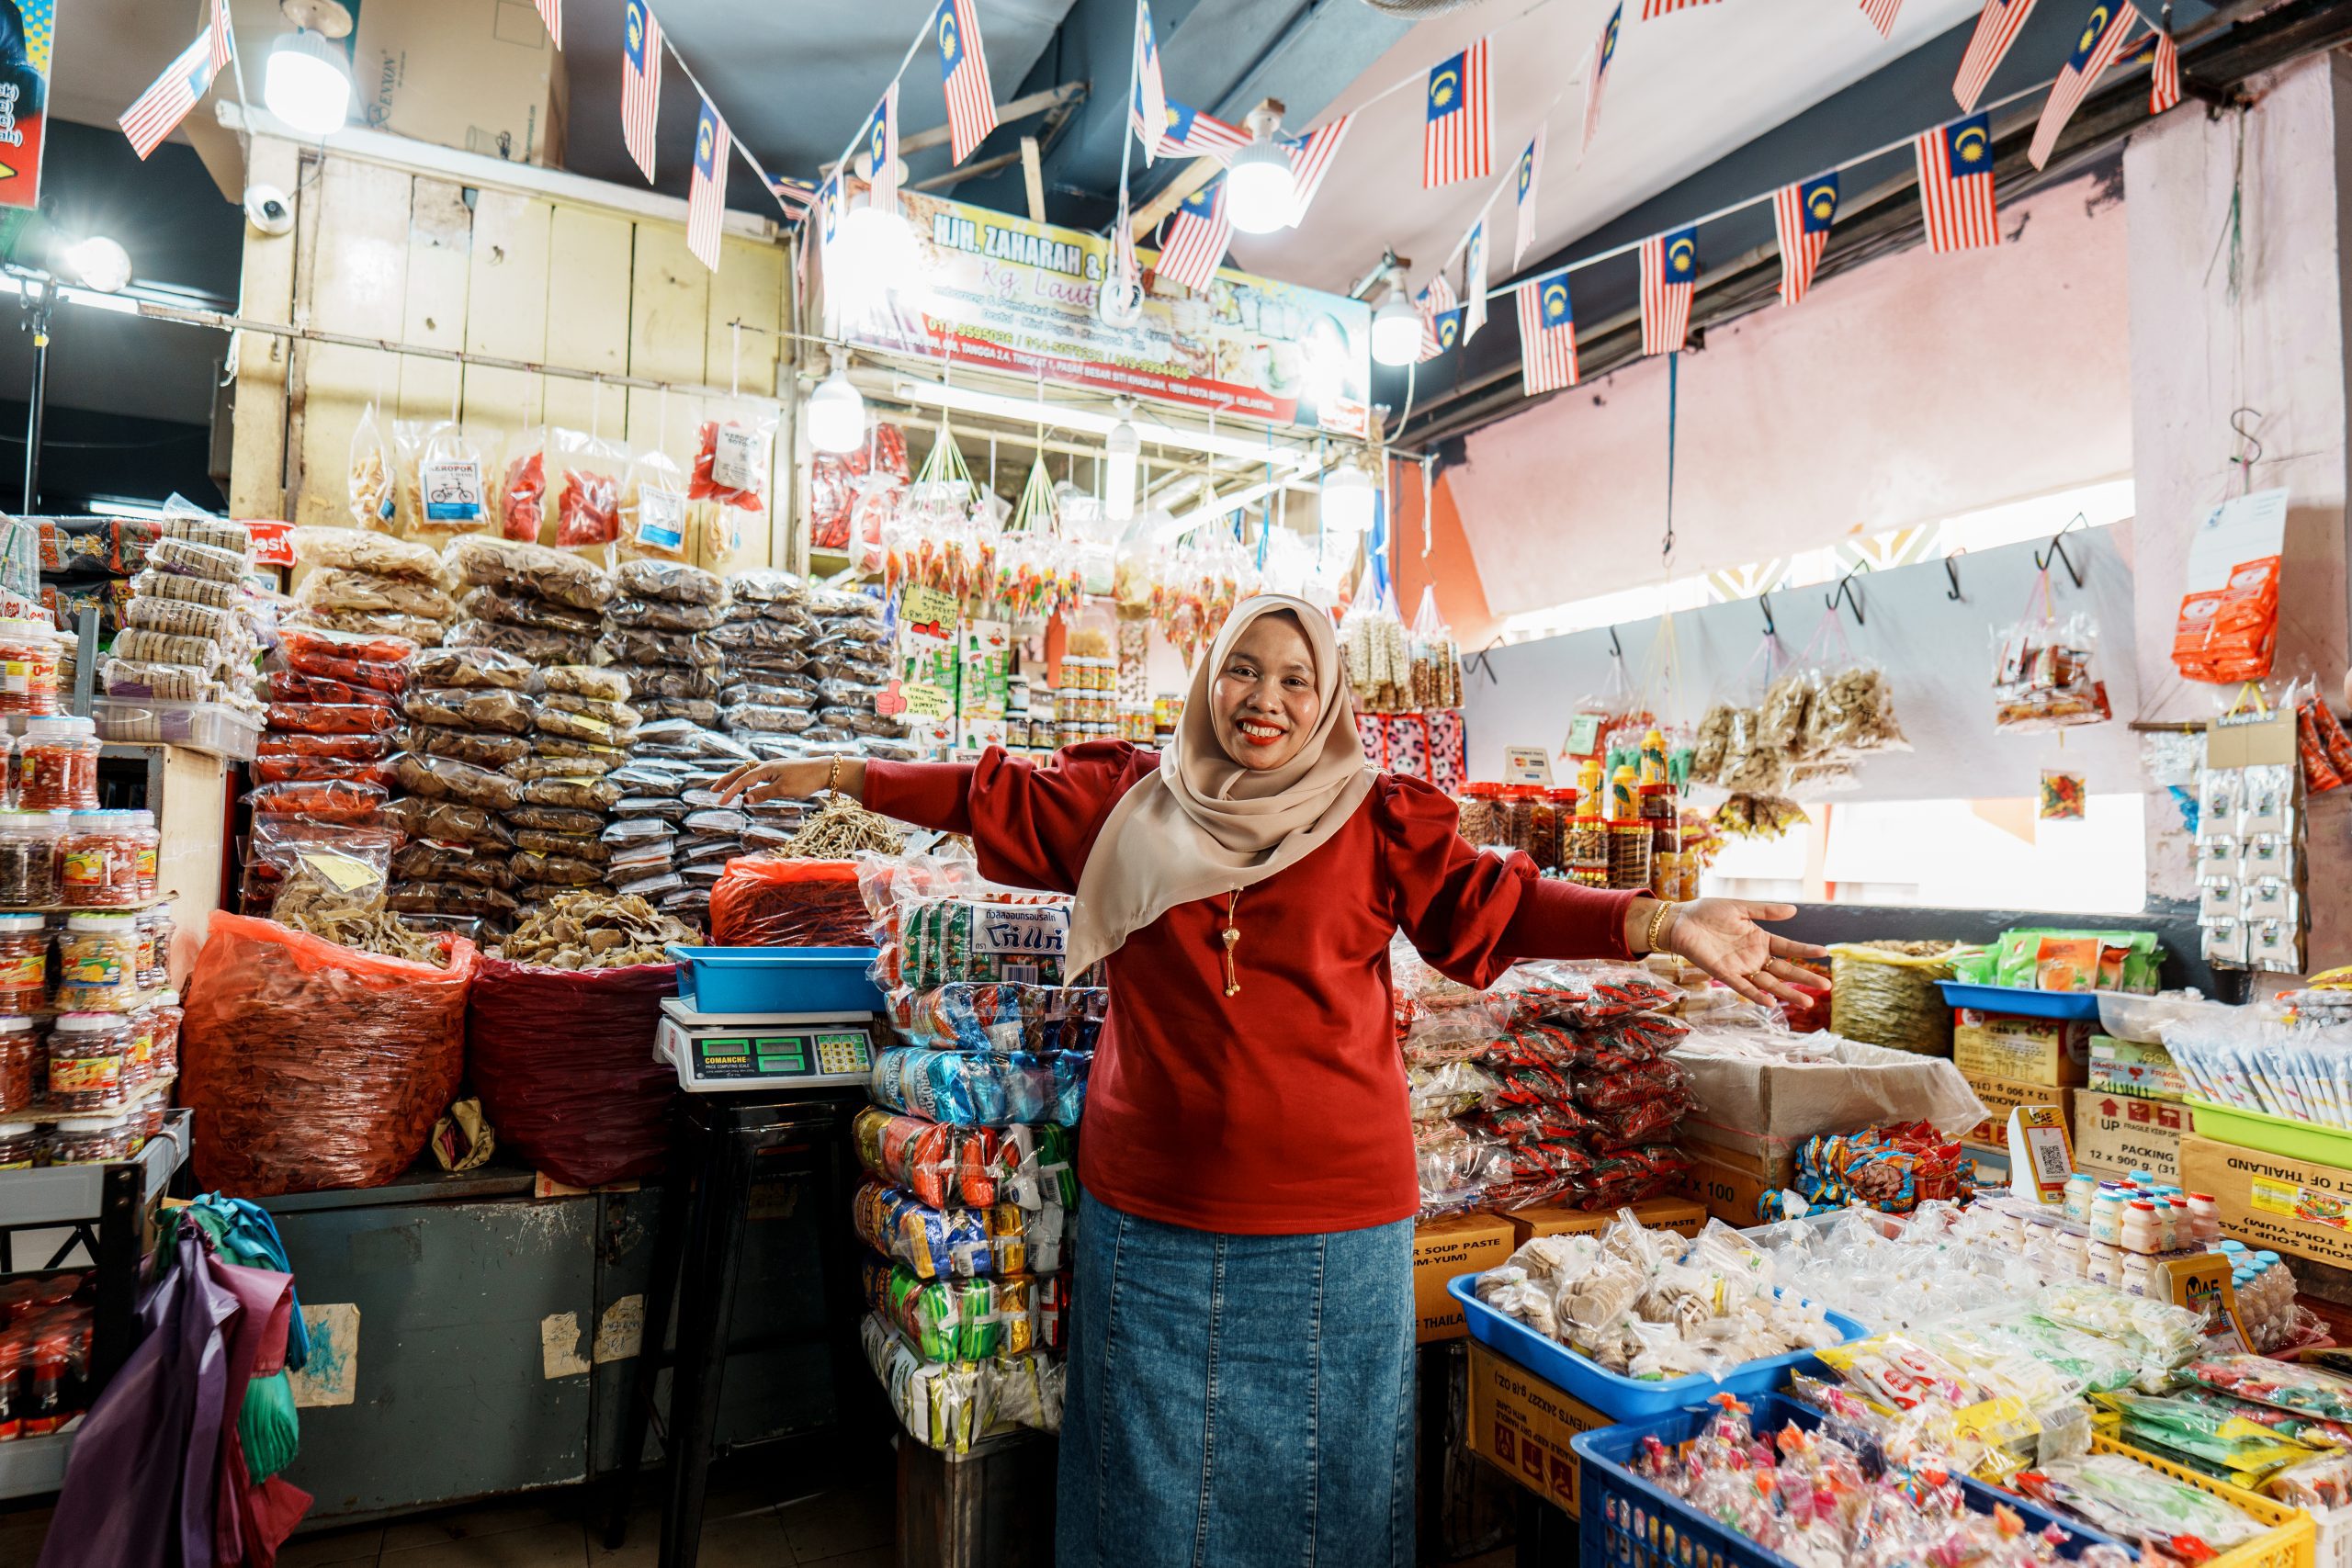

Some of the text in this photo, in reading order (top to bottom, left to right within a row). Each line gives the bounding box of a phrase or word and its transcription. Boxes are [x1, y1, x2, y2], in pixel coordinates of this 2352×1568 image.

[933, 212, 980, 254] HJH.
[984, 224, 1082, 276] ZAHARAH
[1084, 254, 1101, 281] &
[1035, 270, 1099, 307] Laut
[2007, 1087, 2024, 1097] 900
[2038, 1092, 2049, 1100] 12
[1978, 1093, 2021, 1107] PACKING
[2100, 1119, 2120, 1131] UP
[2123, 1122, 2149, 1133] FRAGILE
[2089, 1149, 2102, 1160] 12
[2117, 1156, 2138, 1167] 900
[2121, 1145, 2174, 1162] PACKING
[2227, 1157, 2304, 1183] THAILAND
[2311, 1177, 2331, 1189] OF
[1691, 1181, 1702, 1190] x
[1707, 1183, 1735, 1202] 100
[1641, 1221, 1661, 1231] OUP
[1665, 1218, 1696, 1228] PASTE
[2218, 1221, 2249, 1234] PAS
[2244, 1217, 2335, 1247] TOM-YUM)
[2057, 1242, 2077, 1251] Grape
[2255, 1232, 2300, 1247] SOUP
[1425, 1244, 1458, 1256] SOUP
[1463, 1238, 1500, 1250] PASTE
[2091, 1252, 2111, 1261] Grape
[2126, 1263, 2148, 1272] Grape
[1423, 1314, 1467, 1329] THAILA
[1528, 1393, 1557, 1416] 24X227
